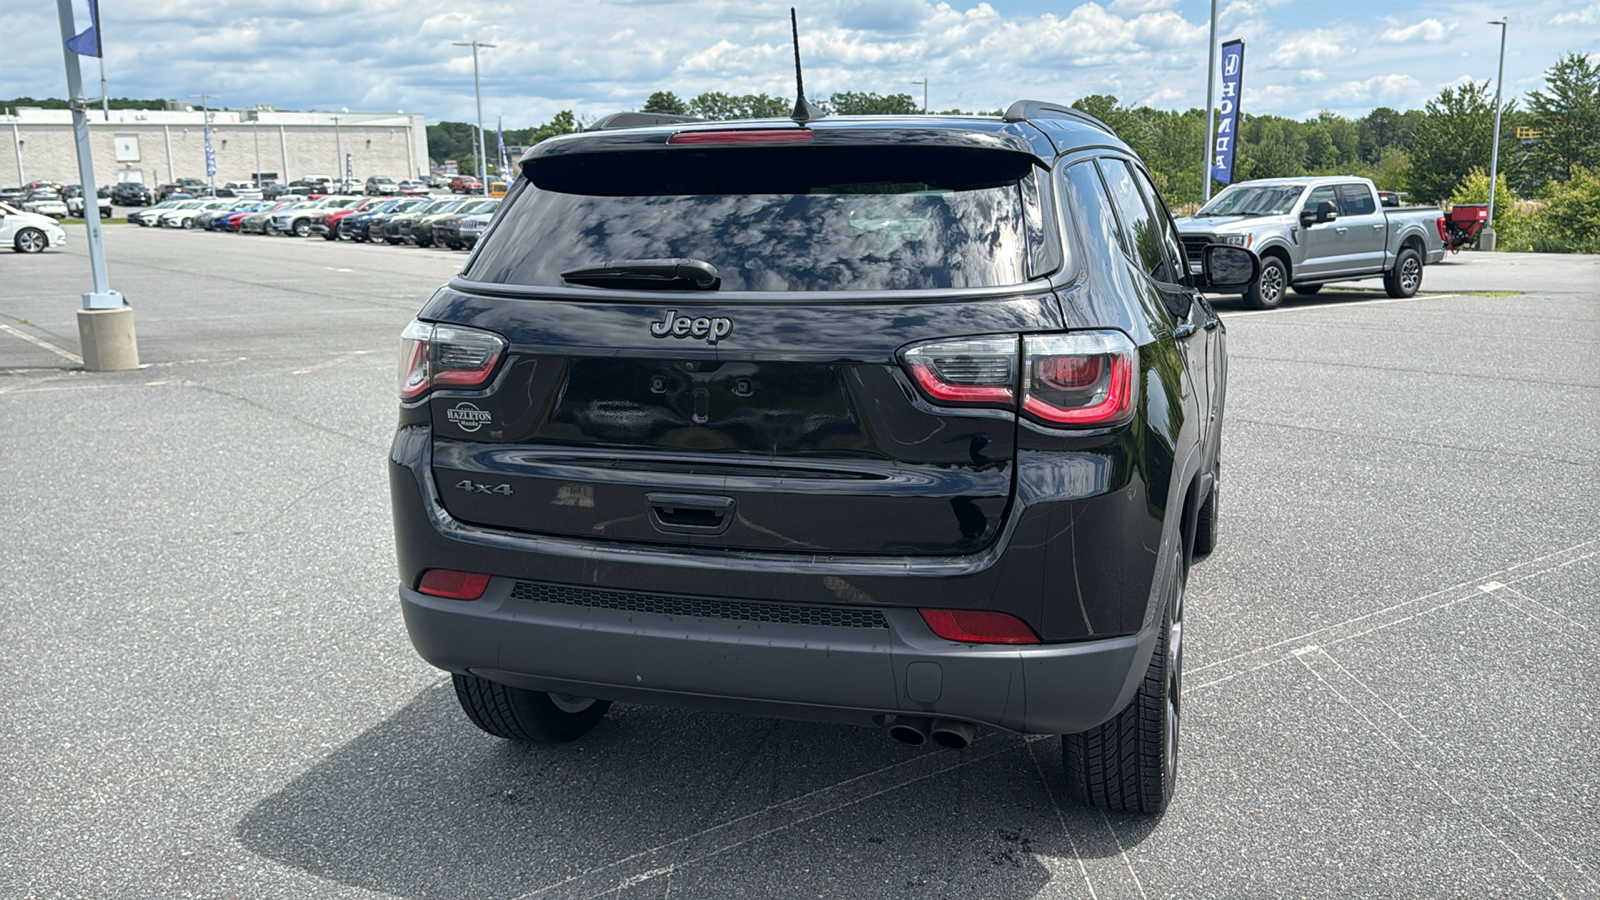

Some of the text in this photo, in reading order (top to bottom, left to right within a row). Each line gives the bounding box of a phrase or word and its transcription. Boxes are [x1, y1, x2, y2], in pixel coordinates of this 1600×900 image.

[650, 310, 733, 344] Jeep
[447, 411, 492, 421] HAZLETON
[455, 480, 514, 496] 4x4
